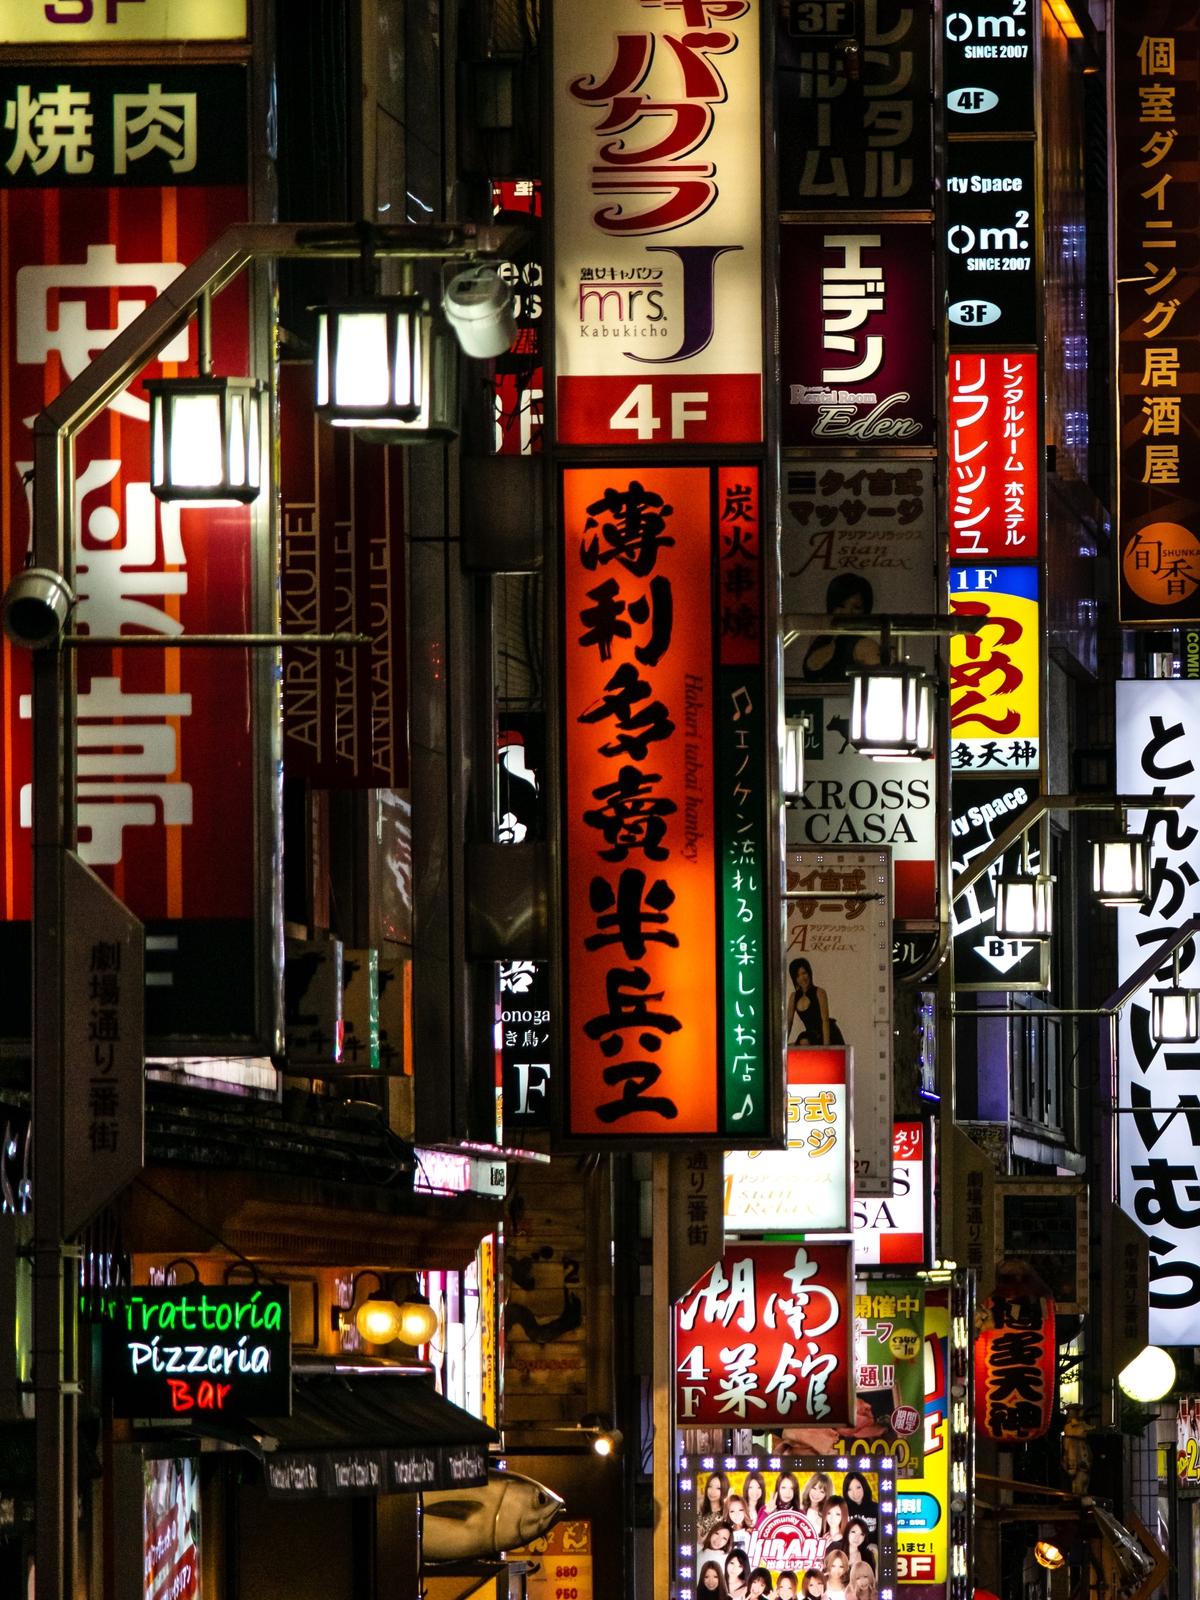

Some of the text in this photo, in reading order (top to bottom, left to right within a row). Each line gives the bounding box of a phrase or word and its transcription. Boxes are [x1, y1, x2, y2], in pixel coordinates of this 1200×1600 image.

[964, 45, 1028, 59] SINCE 2007
[957, 92, 985, 108] 4F
[4, 83, 199, 176] 焼肉
[970, 174, 1022, 193] Space
[967, 257, 1031, 272] SINCE 2007
[1136, 34, 1182, 486] 個室ダイニング居酒屋
[822, 234, 885, 383] エデン
[960, 304, 987, 322] 3F
[580, 324, 668, 338] Kabukicho
[609, 383, 709, 440] 4F
[811, 392, 922, 438] Eden
[952, 358, 991, 554] リフレッシュ
[1003, 357, 1026, 546] レンタルルーム ホステル
[788, 498, 923, 526] マッサージ
[956, 569, 998, 590] 1F
[1126, 534, 1200, 597] 旬香
[970, 786, 1029, 828] Space
[804, 812, 918, 844] CASA
[988, 940, 1019, 956] B1
[89, 941, 120, 1153] 劇場通り一番街
[166, 1378, 233, 1412] Bar
